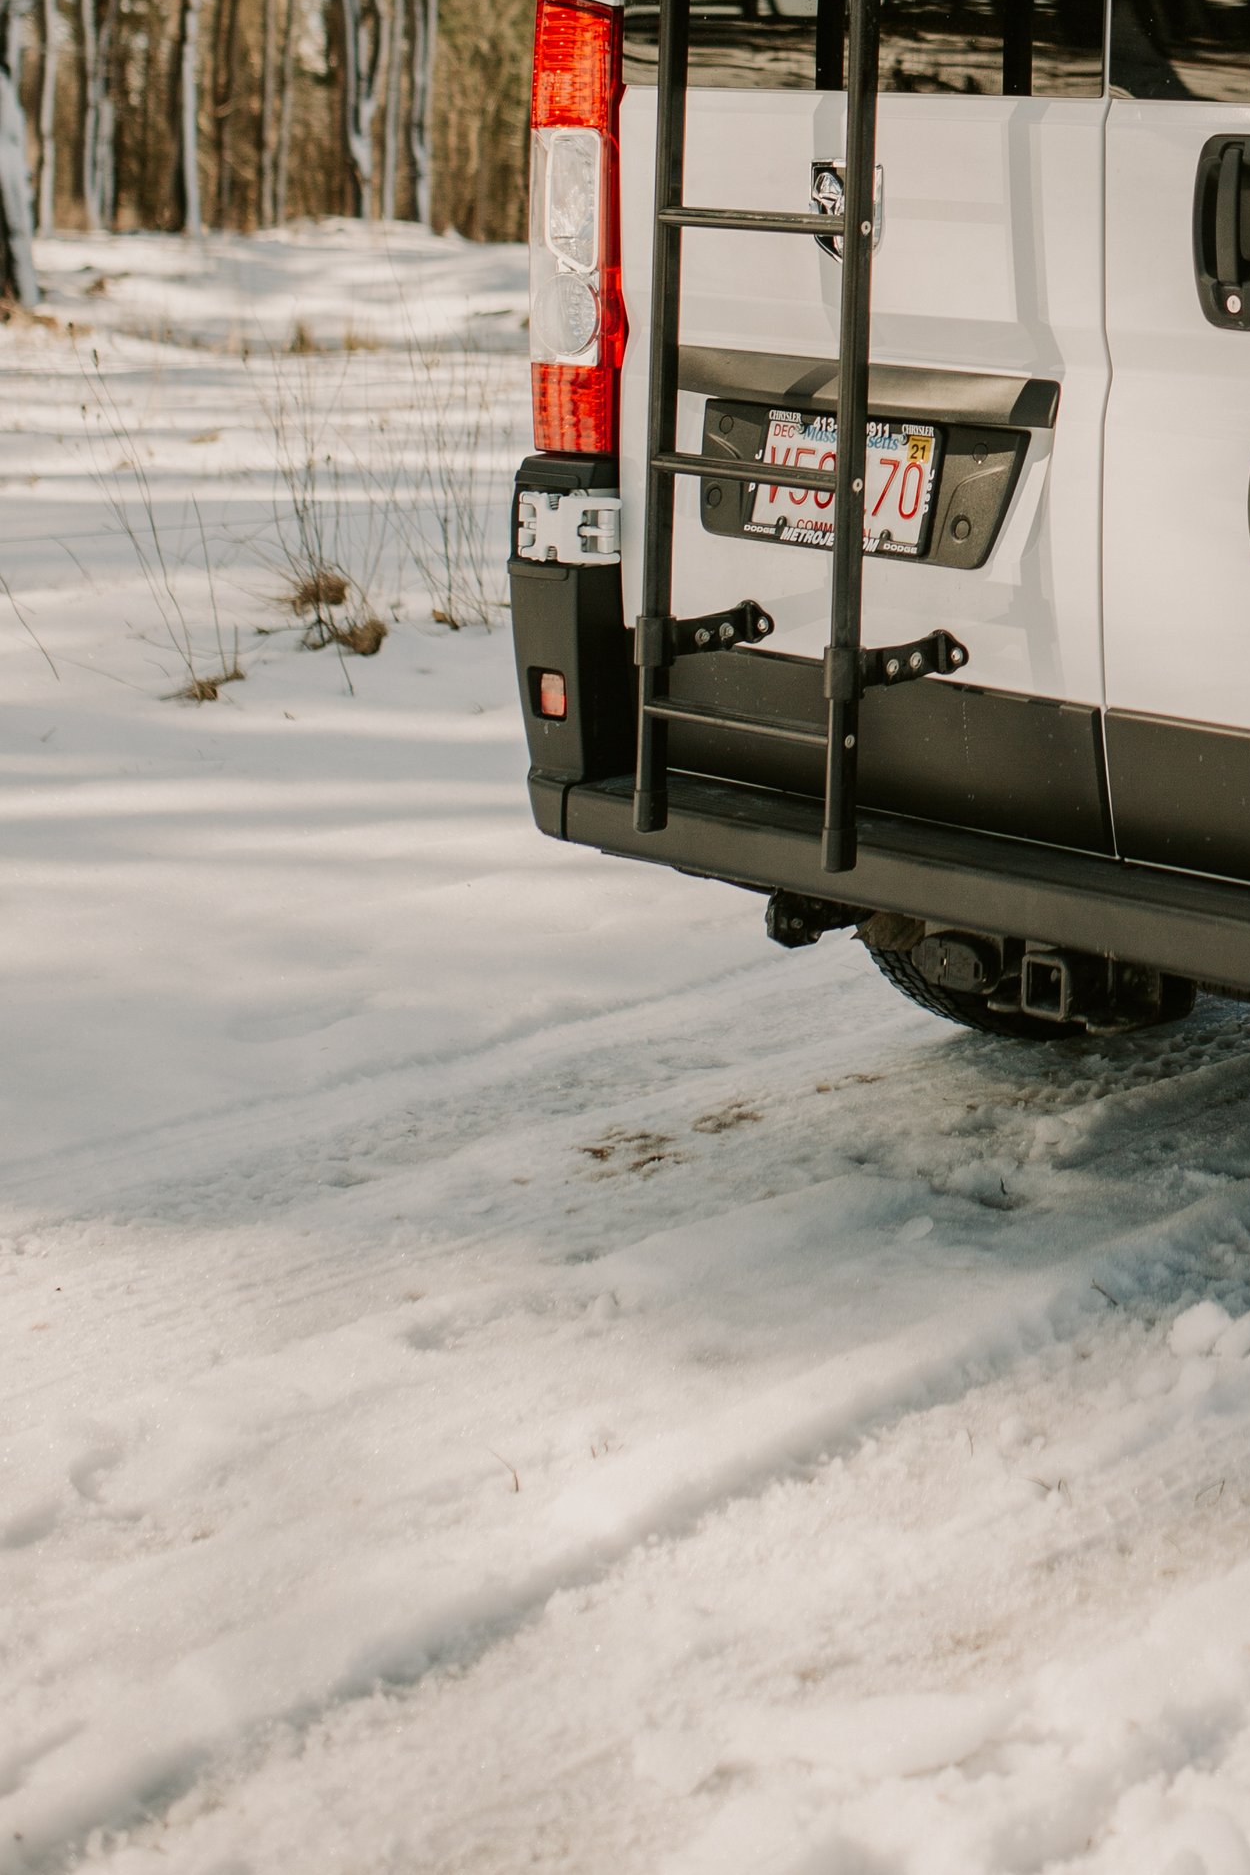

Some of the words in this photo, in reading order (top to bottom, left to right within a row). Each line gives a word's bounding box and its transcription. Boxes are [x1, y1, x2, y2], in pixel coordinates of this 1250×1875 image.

[769, 409, 802, 424] CHRYSLER
[773, 423, 796, 439] DEC
[901, 424, 935, 437] CHRYSLER
[910, 443, 926, 460] 21
[744, 524, 776, 535] DODGE
[883, 542, 918, 555] DODGE
